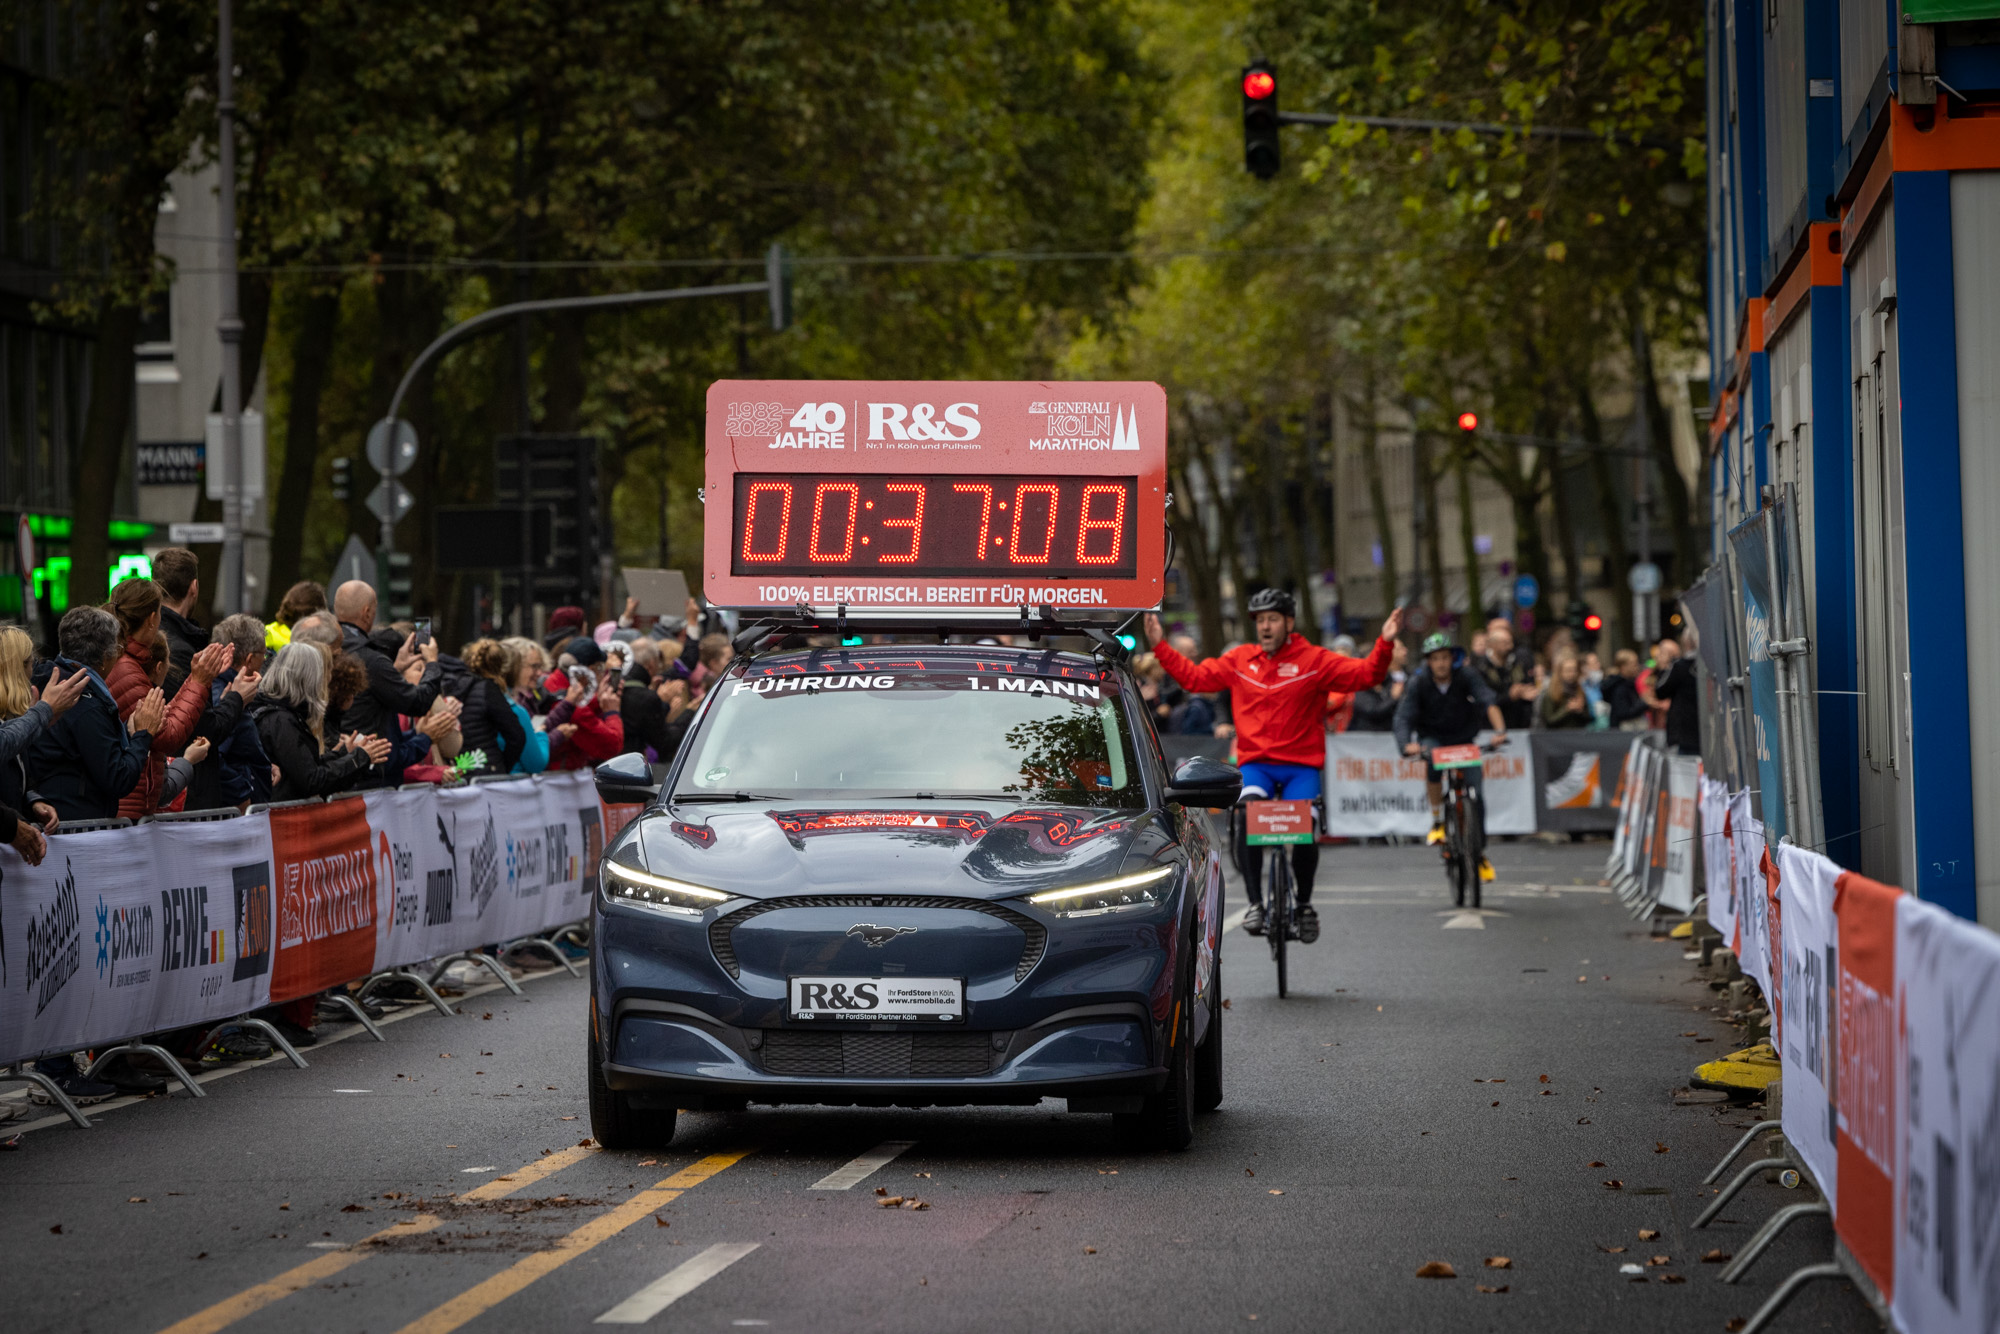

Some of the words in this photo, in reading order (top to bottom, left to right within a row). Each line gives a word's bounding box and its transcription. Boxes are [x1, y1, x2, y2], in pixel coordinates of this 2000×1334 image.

[789, 402, 846, 432] 40
[1048, 402, 1110, 414] GENERALI
[726, 419, 783, 437] 2022
[867, 403, 981, 441] R&S
[1048, 415, 1110, 436] KÖLN
[768, 432, 844, 449] JAHRE
[898, 442, 919, 450] Köln
[1030, 438, 1110, 450] MARATHON
[758, 586, 809, 602] 100%
[814, 586, 922, 602] ELEKTRISCH.
[927, 587, 988, 603] BEREIT
[990, 584, 1025, 603] FÜR
[1029, 587, 1108, 604] MORGEN.
[731, 676, 895, 697] FÜHRUNG
[968, 677, 989, 690] 1.
[998, 678, 1100, 700] MANN
[1258, 814, 1301, 824] Begleitung
[1270, 824, 1289, 832] Elite
[301, 848, 371, 943] GENERALI
[26, 855, 80, 994] Reissdorf
[161, 886, 209, 973] REWE
[109, 904, 154, 988] pixum
[200, 974, 223, 999] GROUP
[799, 983, 880, 1010] R&S
[887, 989, 897, 997] Ihr
[897, 989, 931, 997] FordStore
[932, 989, 938, 997] in
[939, 989, 955, 997] Köln.
[798, 1012, 815, 1020] R&S
[845, 1013, 877, 1021] FordStore
[878, 1013, 902, 1021] Partner
[902, 1013, 917, 1021] Köln
